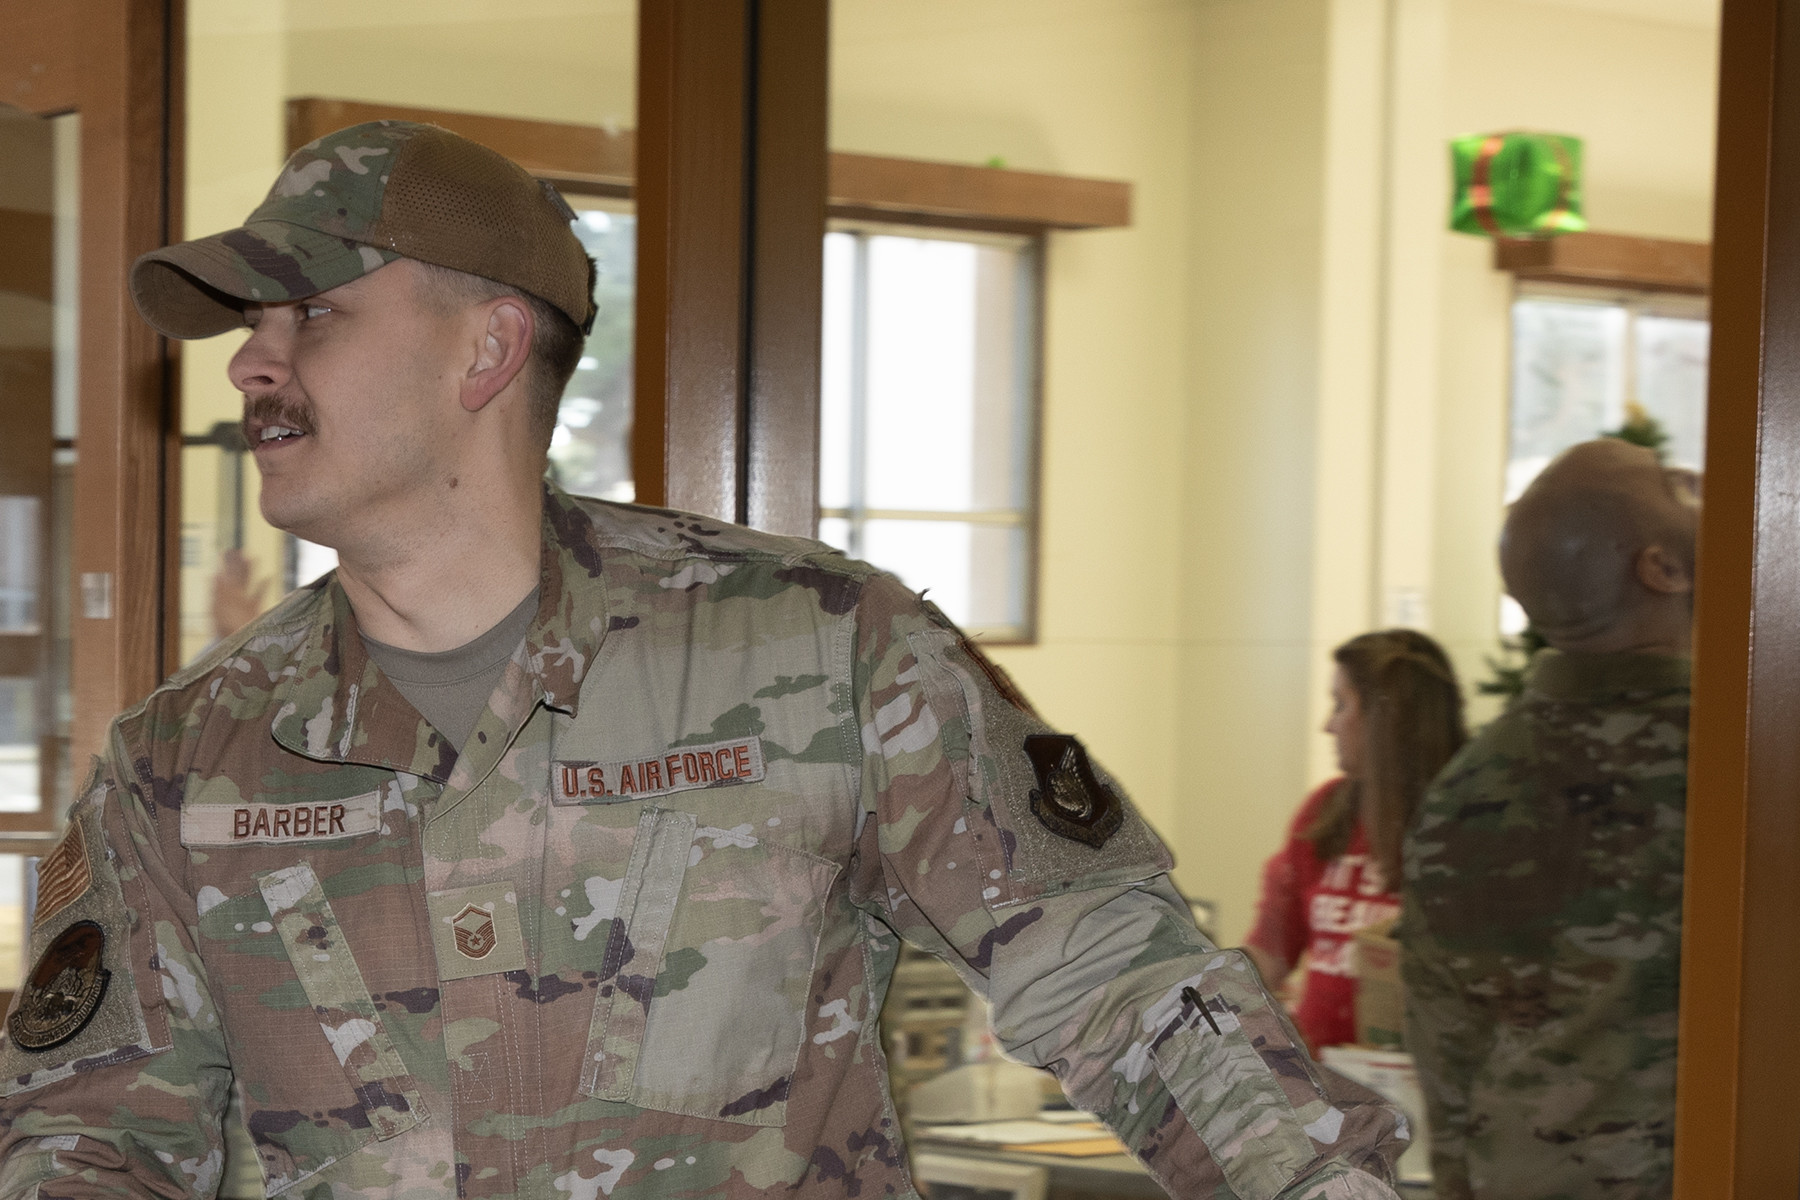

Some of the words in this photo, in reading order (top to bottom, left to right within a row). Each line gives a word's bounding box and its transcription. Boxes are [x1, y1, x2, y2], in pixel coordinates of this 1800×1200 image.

[562, 766, 613, 798] U.S.
[620, 760, 665, 795] AIR
[665, 745, 752, 787] FORCE
[233, 804, 346, 840] BARBER
